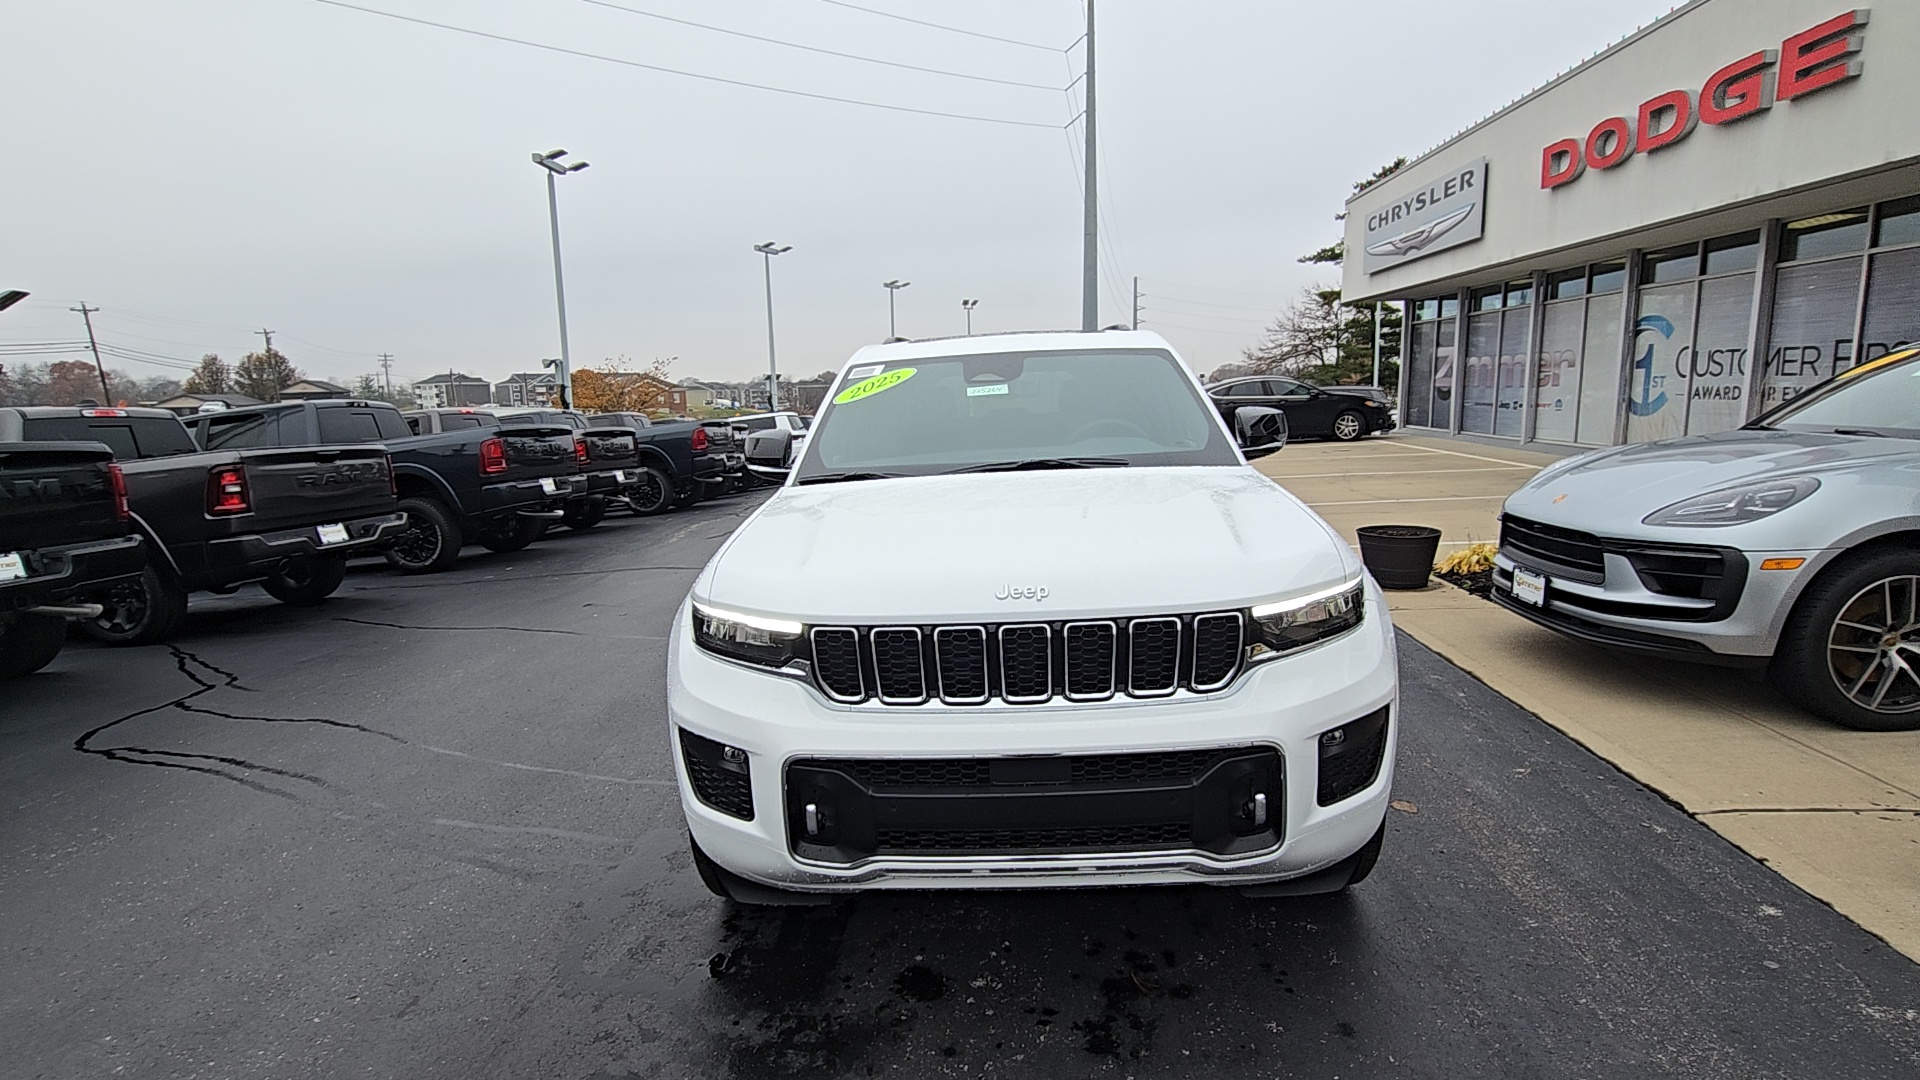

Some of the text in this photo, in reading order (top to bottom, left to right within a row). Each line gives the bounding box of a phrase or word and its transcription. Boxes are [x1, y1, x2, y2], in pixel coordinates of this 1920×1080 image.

[1541, 10, 1870, 190] DODGE
[1368, 165, 1475, 232] CHRYSLER
[1431, 346, 1576, 388] Zmmer
[850, 371, 901, 399] 2025
[1692, 385, 1742, 401] AWARD
[995, 584, 1049, 602] Jeep
